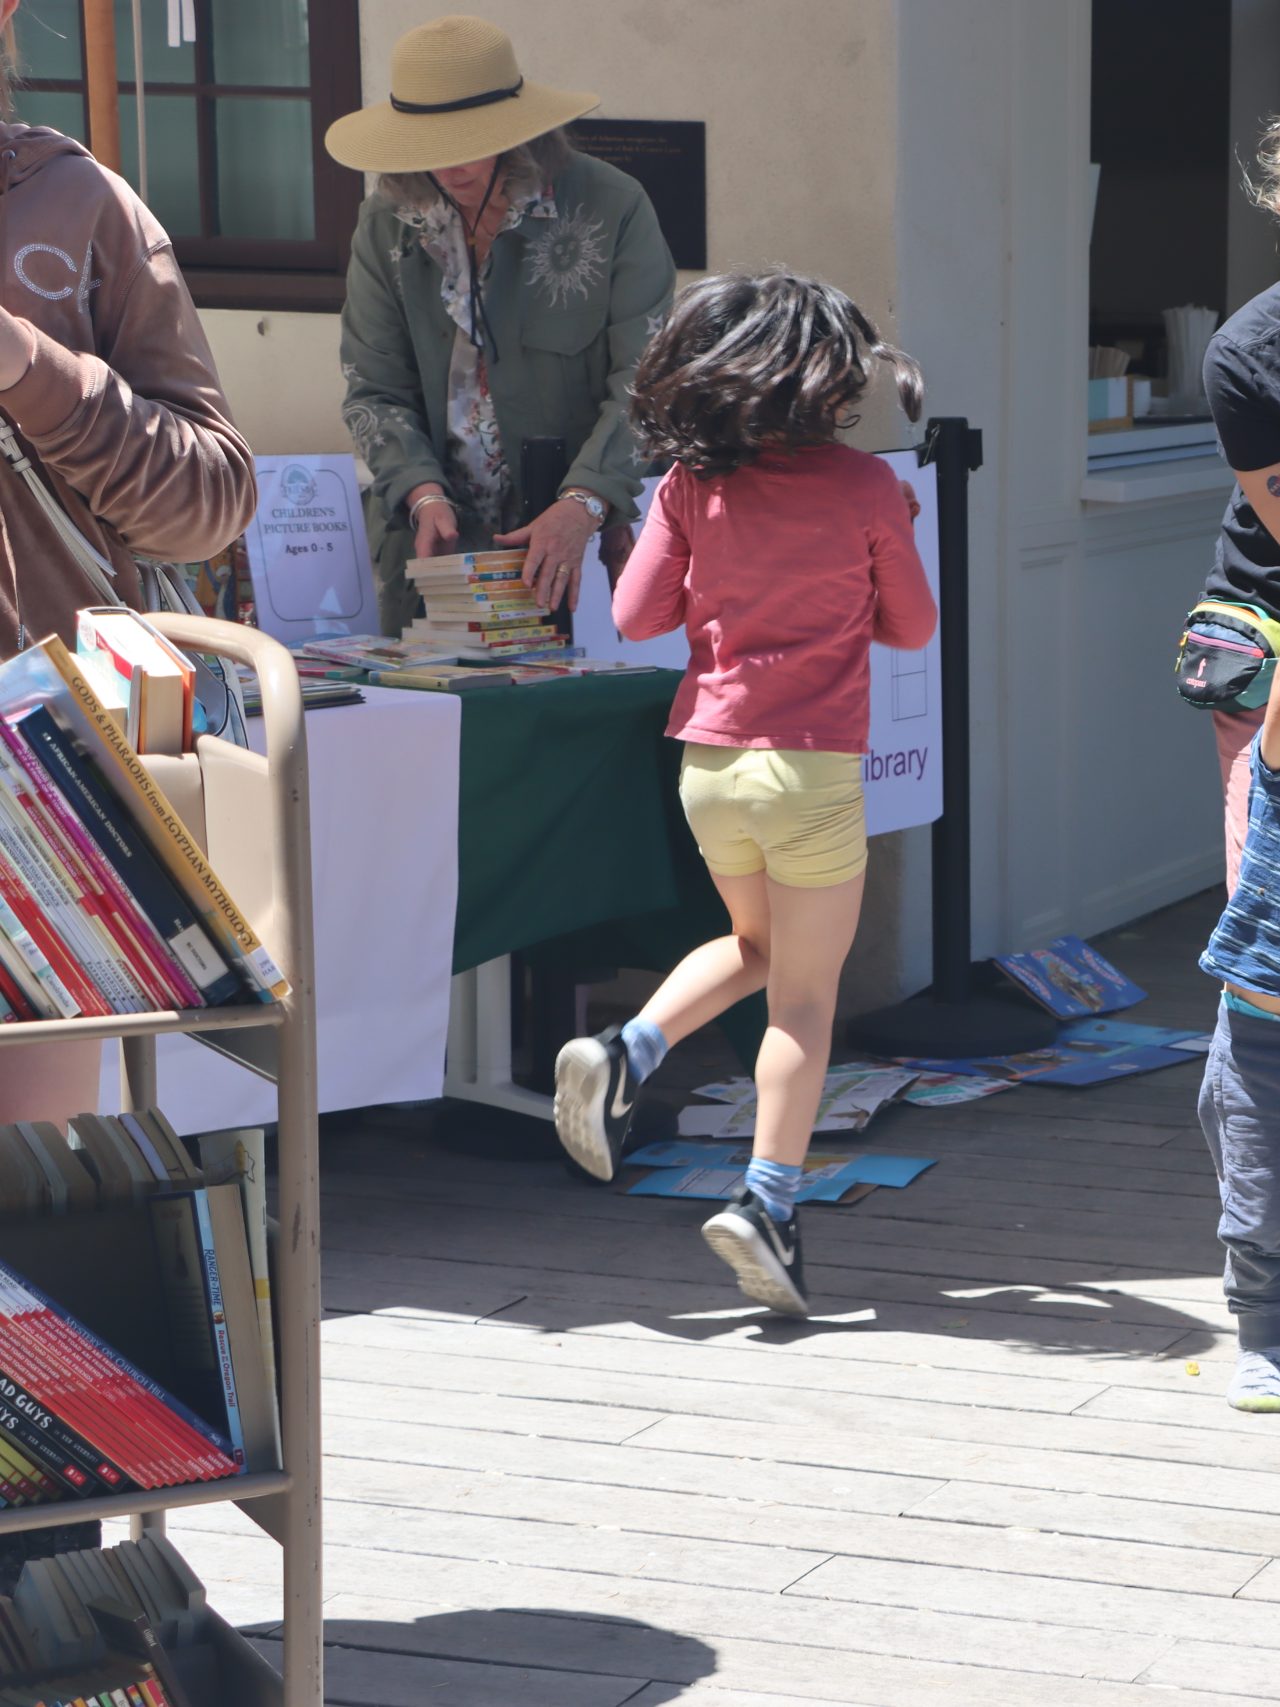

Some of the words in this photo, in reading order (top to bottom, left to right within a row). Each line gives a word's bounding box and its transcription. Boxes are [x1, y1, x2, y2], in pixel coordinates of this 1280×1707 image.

[264, 522, 311, 534] PICTURE
[312, 521, 348, 533] BOOKS
[271, 507, 336, 518] CHILDREN'S
[285, 544, 307, 555] Ages
[865, 747, 928, 782] ibrary
[69, 674, 101, 714] GODS
[94, 711, 107, 724] &
[101, 722, 152, 792] PHARAOHS
[145, 789, 169, 817] from
[162, 814, 207, 876] EGYPTIAN
[201, 873, 256, 949] MYTHOLOGY
[103, 818, 133, 859] DOCTORS
[3, 826, 32, 866] COMMANDER
[28, 864, 43, 882] TOAD
[39, 880, 48, 889] IN
[44, 887, 60, 907] SPACE
[11, 823, 41, 865] COMMANDER
[38, 862, 52, 880] TOAD
[48, 878, 57, 887] IN
[54, 885, 70, 906] SPACE
[48, 862, 62, 879] TOAD
[18, 864, 33, 882] TOAD
[29, 881, 38, 889] IN
[35, 888, 50, 907] SPACE
[203, 1248, 217, 1282] RANGER
[209, 1286, 221, 1306] TIME
[5, 1322, 22, 1336] FROG
[19, 1333, 33, 1346] AND
[31, 1342, 49, 1358] TOAD
[46, 1355, 72, 1377] TOGETHER
[6, 1334, 21, 1348] AND
[19, 1344, 37, 1360] TOAD
[34, 1357, 61, 1380] TOGETHER
[18, 1320, 35, 1335] FROG
[32, 1331, 48, 1345] AND
[45, 1341, 62, 1357] TOAD
[60, 1353, 73, 1366] ARE
[70, 1362, 94, 1383] FRIENDS
[29, 1317, 45, 1332] FROG
[43, 1328, 58, 1342] AND
[56, 1339, 73, 1354] TOAD
[70, 1350, 83, 1363] ARE
[81, 1359, 105, 1380] FRIENDS
[38, 1315, 55, 1330] FROG
[53, 1327, 68, 1340] AND
[65, 1337, 82, 1352] TOAD
[80, 1349, 93, 1361] ARE
[90, 1357, 114, 1378] FRIENDS
[49, 1314, 64, 1328] FROG
[62, 1325, 77, 1339] AND
[75, 1336, 92, 1351] TOAD
[90, 1347, 103, 1360] ARE
[100, 1356, 124, 1377] FRIENDS
[63, 1315, 103, 1350] MYSTERY
[100, 1346, 115, 1360] ON
[113, 1356, 149, 1387] CHURCH
[146, 1382, 168, 1402] HILL
[216, 1329, 228, 1355] Rescue
[9, 1347, 25, 1361] TOAD
[23, 1358, 50, 1382] TOGETHER
[12, 1359, 38, 1383] TOGETHER
[221, 1362, 232, 1390] Oregon
[0, 1376, 18, 1398] AD
[12, 1392, 54, 1430] GUYS
[226, 1391, 235, 1407] Trail
[186, 1459, 204, 1474] HARPER
[196, 1455, 215, 1471] HARPER
[206, 1453, 224, 1469] HARPER
[217, 1451, 234, 1467] HARPER
